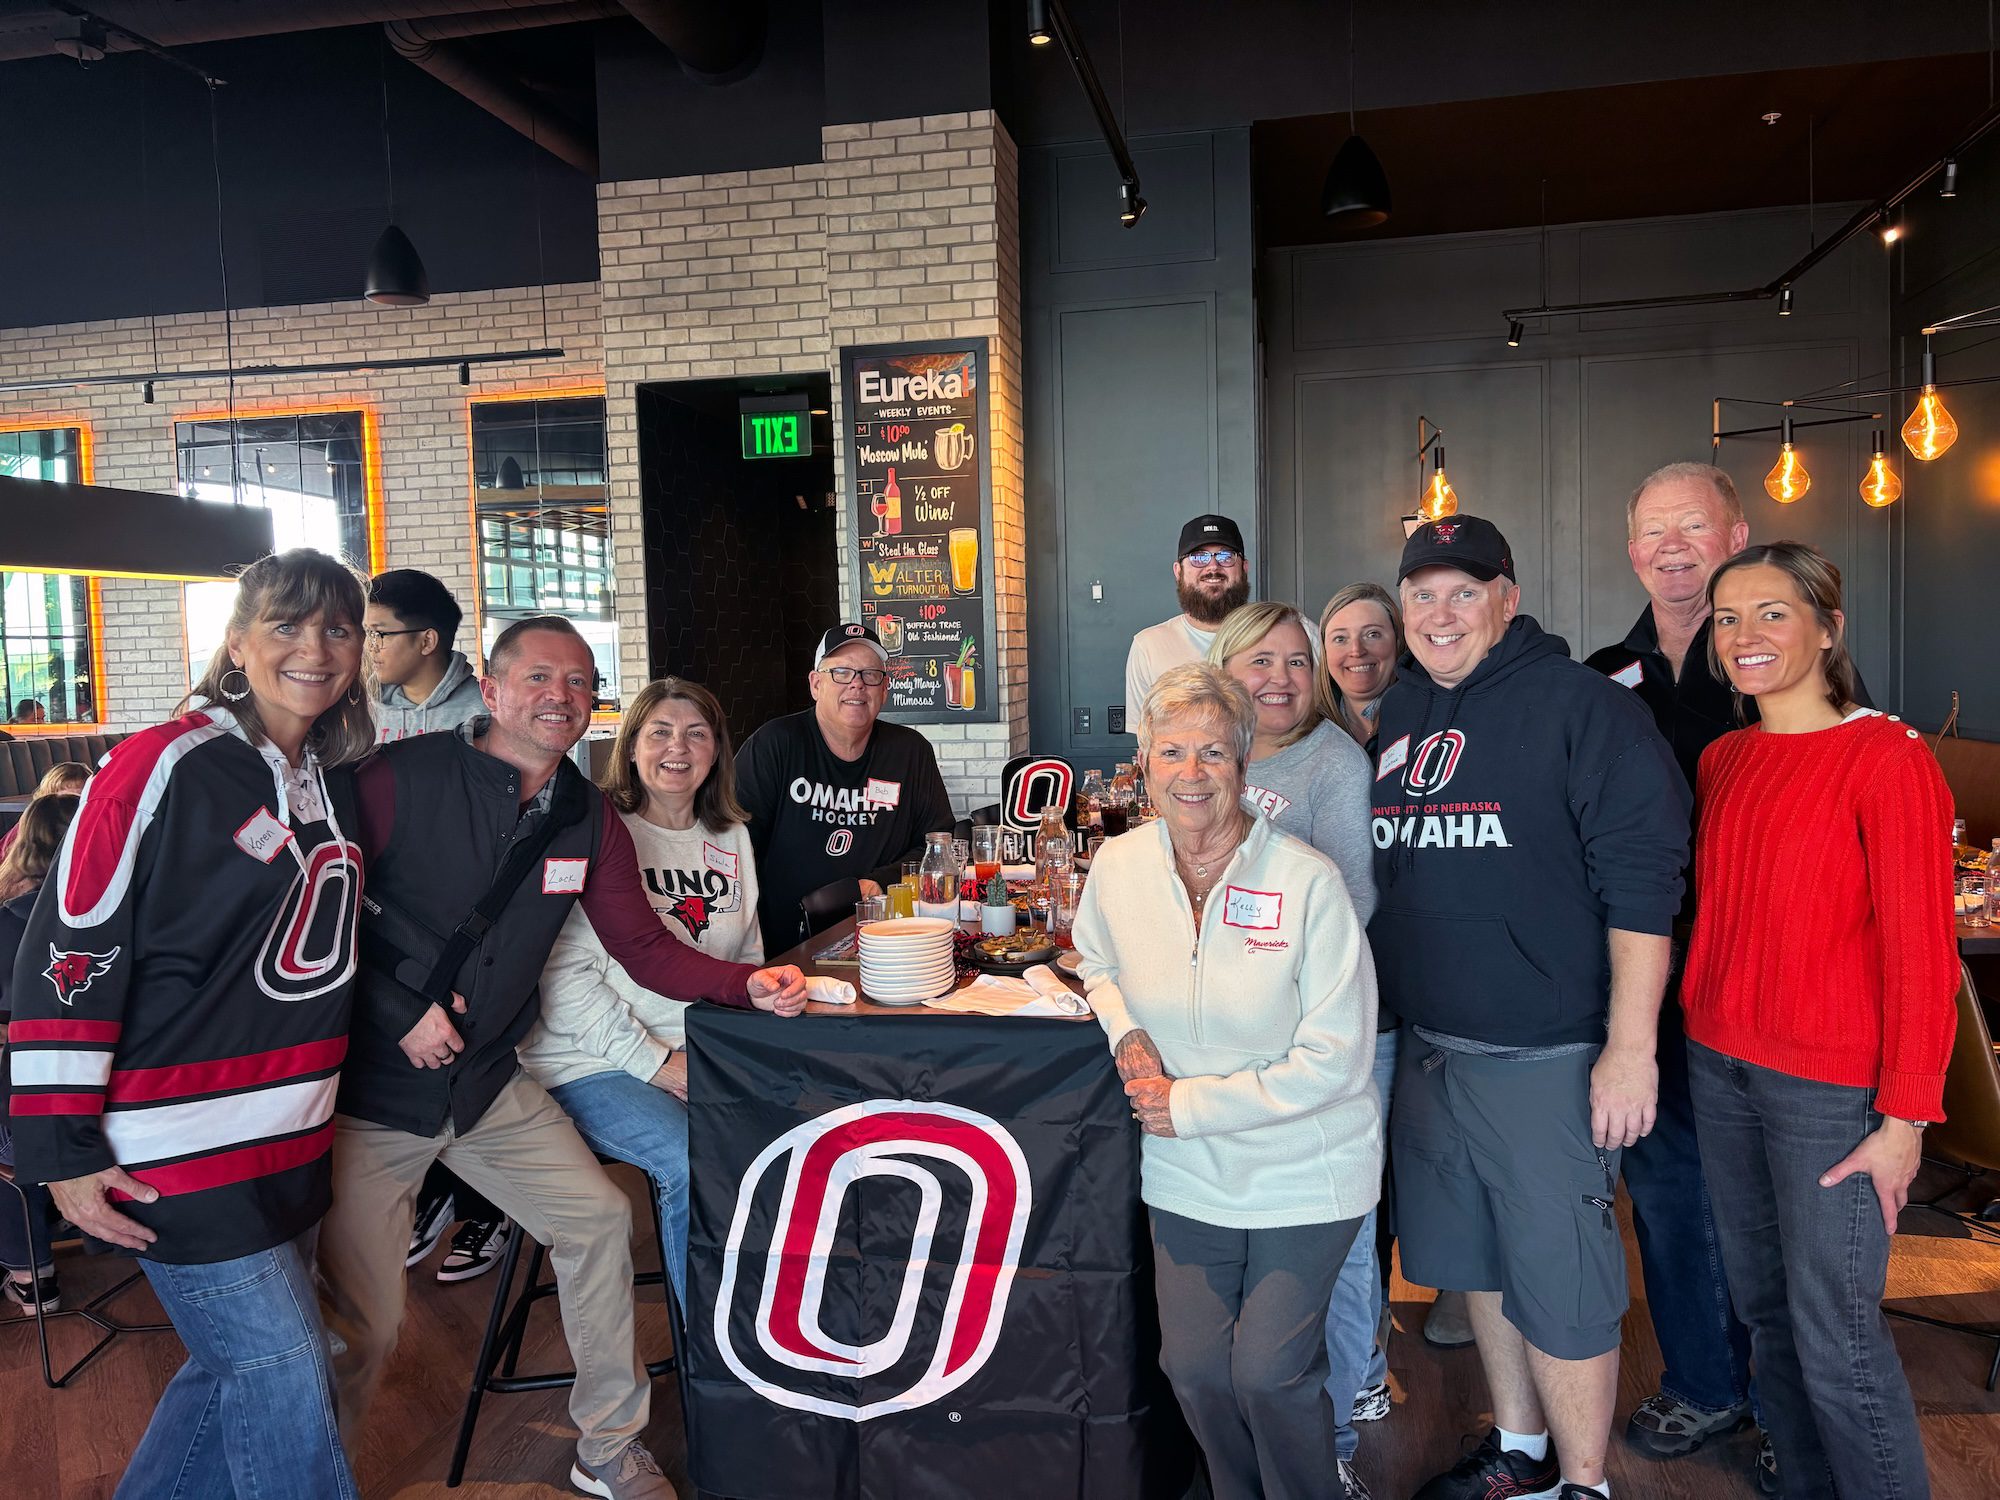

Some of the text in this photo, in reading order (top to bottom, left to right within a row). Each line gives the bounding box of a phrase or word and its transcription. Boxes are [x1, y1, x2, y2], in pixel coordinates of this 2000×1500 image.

[859, 366, 969, 403] Eureka!
[931, 486, 951, 499] OFF
[915, 501, 955, 522] Wine!
[903, 542, 915, 556] the
[896, 584, 950, 595] TURNOUT IPA
[863, 602, 874, 612] Th
[906, 621, 962, 630] BUFFALO TRACE
[893, 693, 934, 706] Mimosas
[1244, 784, 1292, 821] KEY
[1424, 804, 1438, 814] OF
[1441, 801, 1501, 813] NEBRASKA
[812, 808, 878, 826] HOCKEY
[247, 829, 276, 854] Karen
[643, 867, 728, 897] UNO
[1245, 937, 1289, 948] Mavericks
